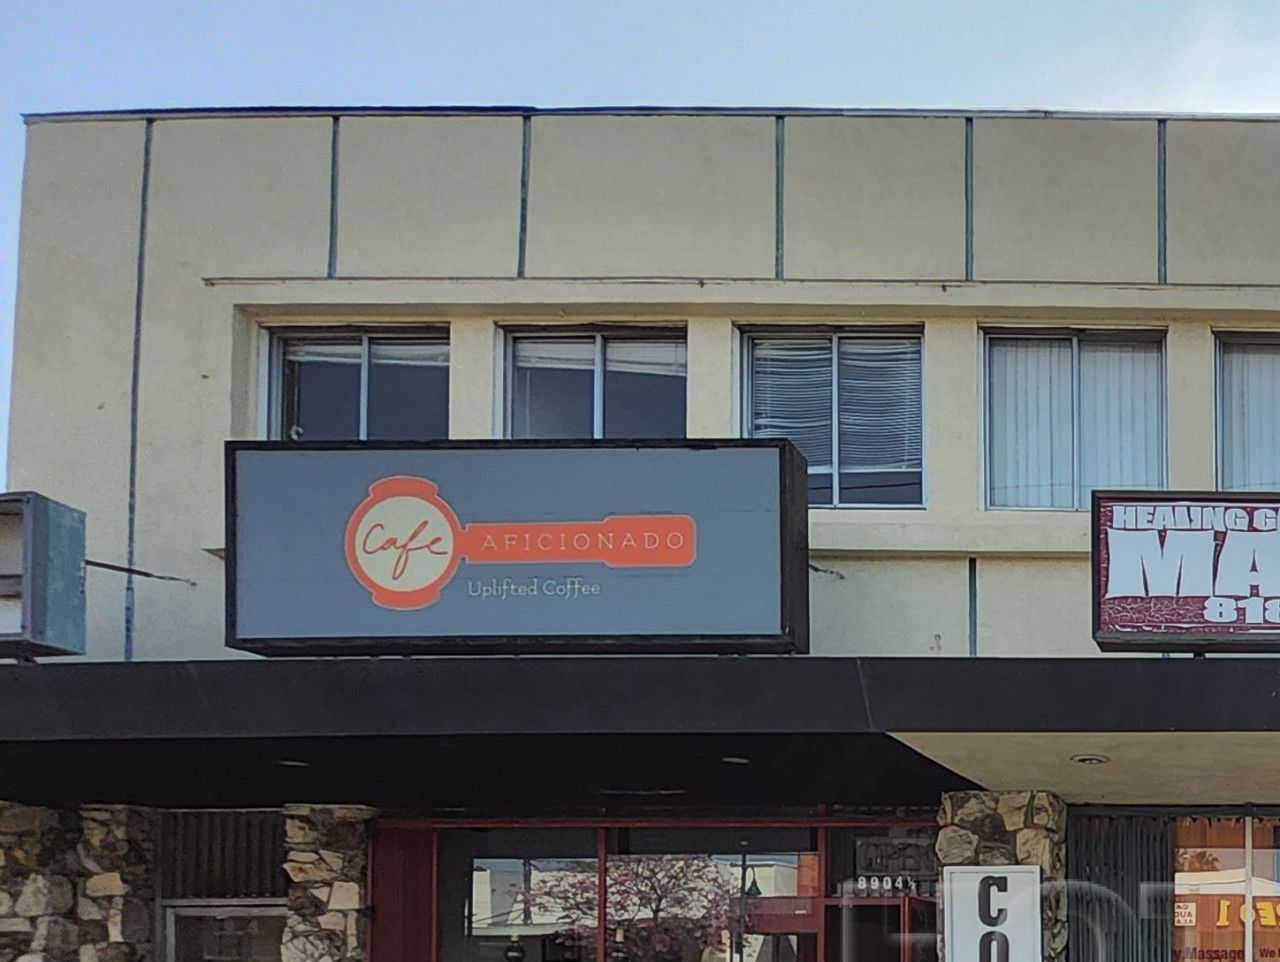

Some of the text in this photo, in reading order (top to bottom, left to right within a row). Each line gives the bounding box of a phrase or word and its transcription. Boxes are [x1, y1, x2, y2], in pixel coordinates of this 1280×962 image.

[1112, 506, 1249, 531] HEALING
[481, 530, 686, 554] AFICIONADO
[468, 577, 600, 599] Uplifted Coffee
[1260, 948, 1275, 958] We
